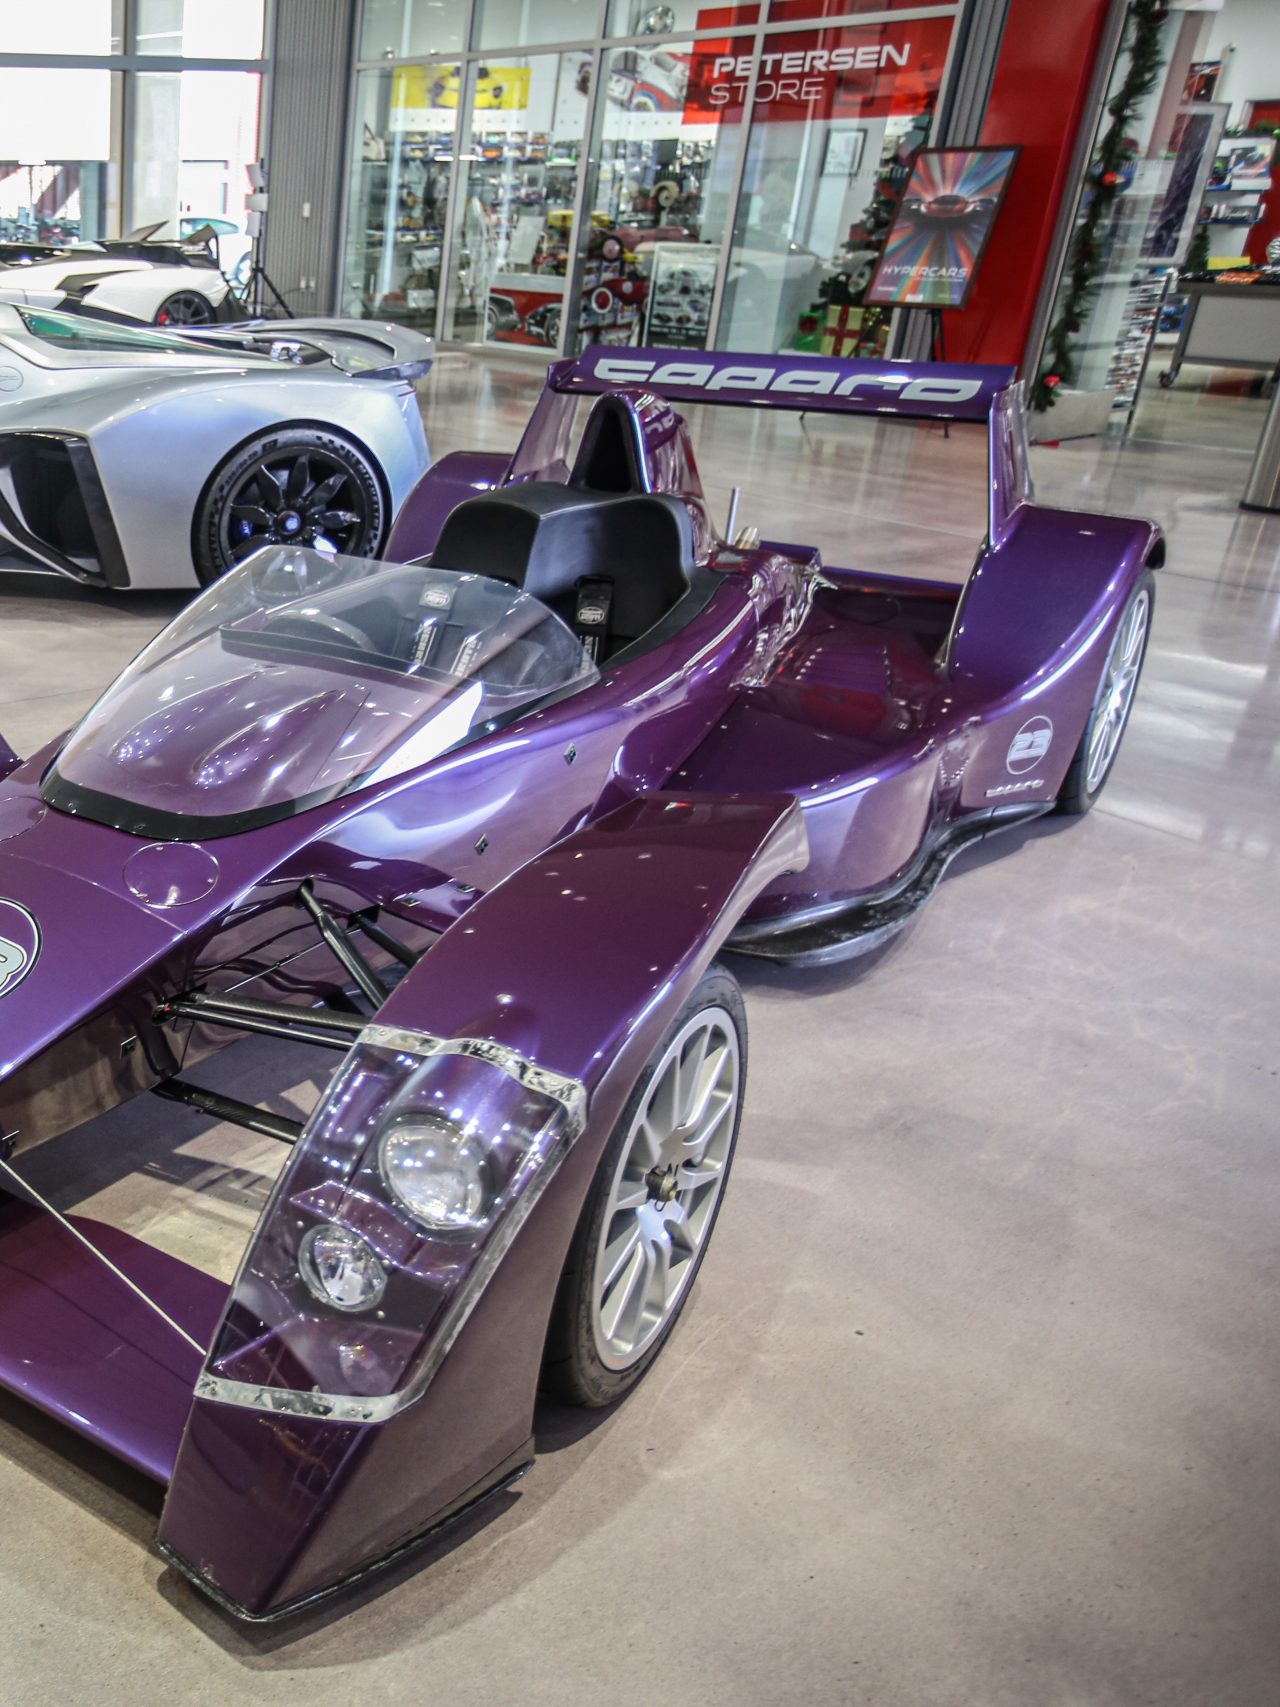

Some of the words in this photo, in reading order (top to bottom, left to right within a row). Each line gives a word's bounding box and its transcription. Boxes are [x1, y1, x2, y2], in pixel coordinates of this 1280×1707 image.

[712, 43, 910, 79] PETERSEN
[709, 78, 825, 105] STORE
[882, 265, 969, 278] HYPERCARS
[593, 358, 982, 402] caparo
[1008, 728, 1051, 762] 23
